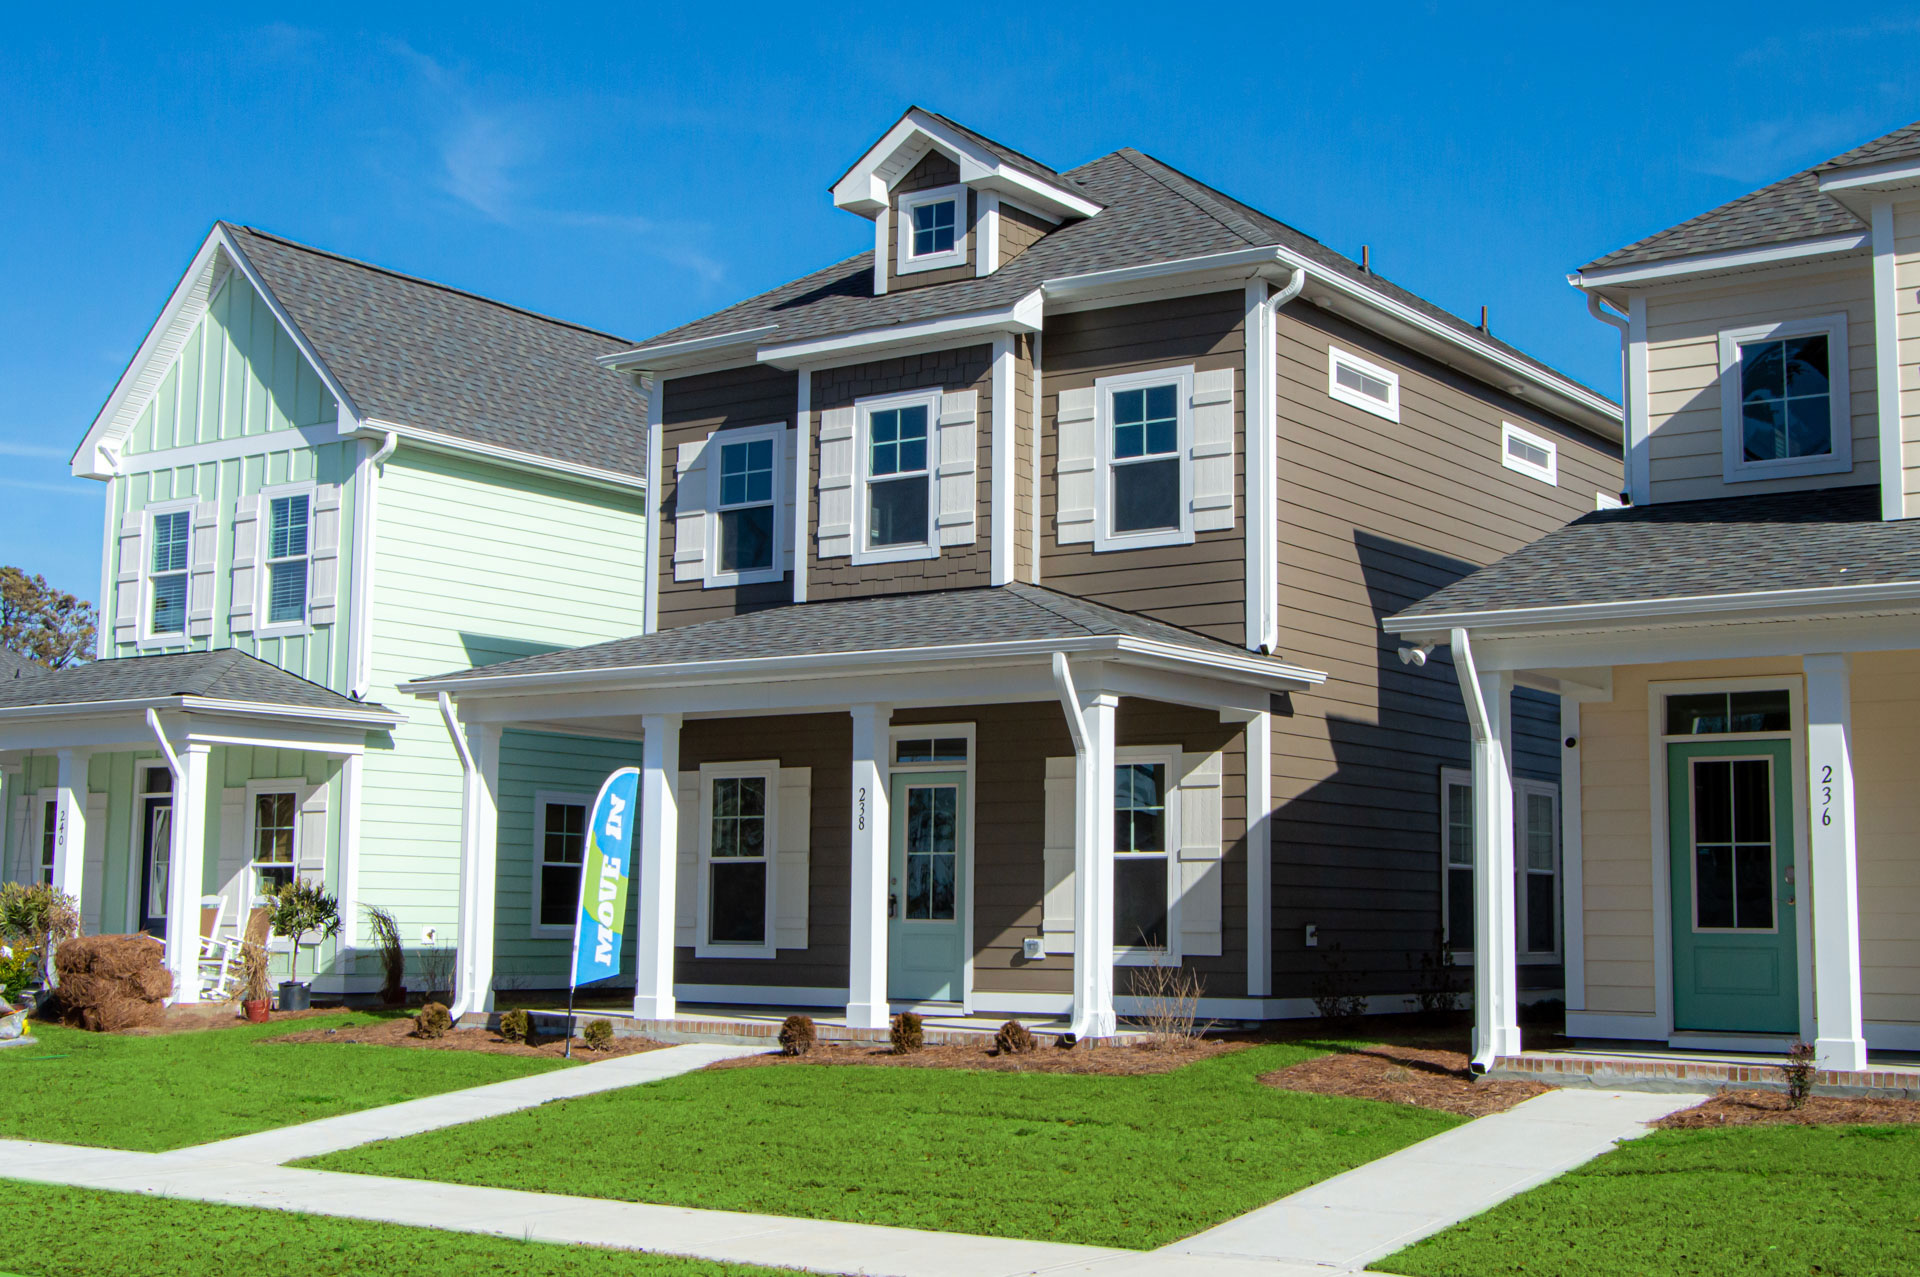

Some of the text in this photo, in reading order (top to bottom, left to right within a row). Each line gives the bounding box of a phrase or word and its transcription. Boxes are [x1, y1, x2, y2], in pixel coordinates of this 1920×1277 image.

[858, 787, 866, 831] 238
[1821, 765, 1833, 827] 236
[58, 810, 66, 846] 240
[594, 793, 627, 967] MOVE IN
